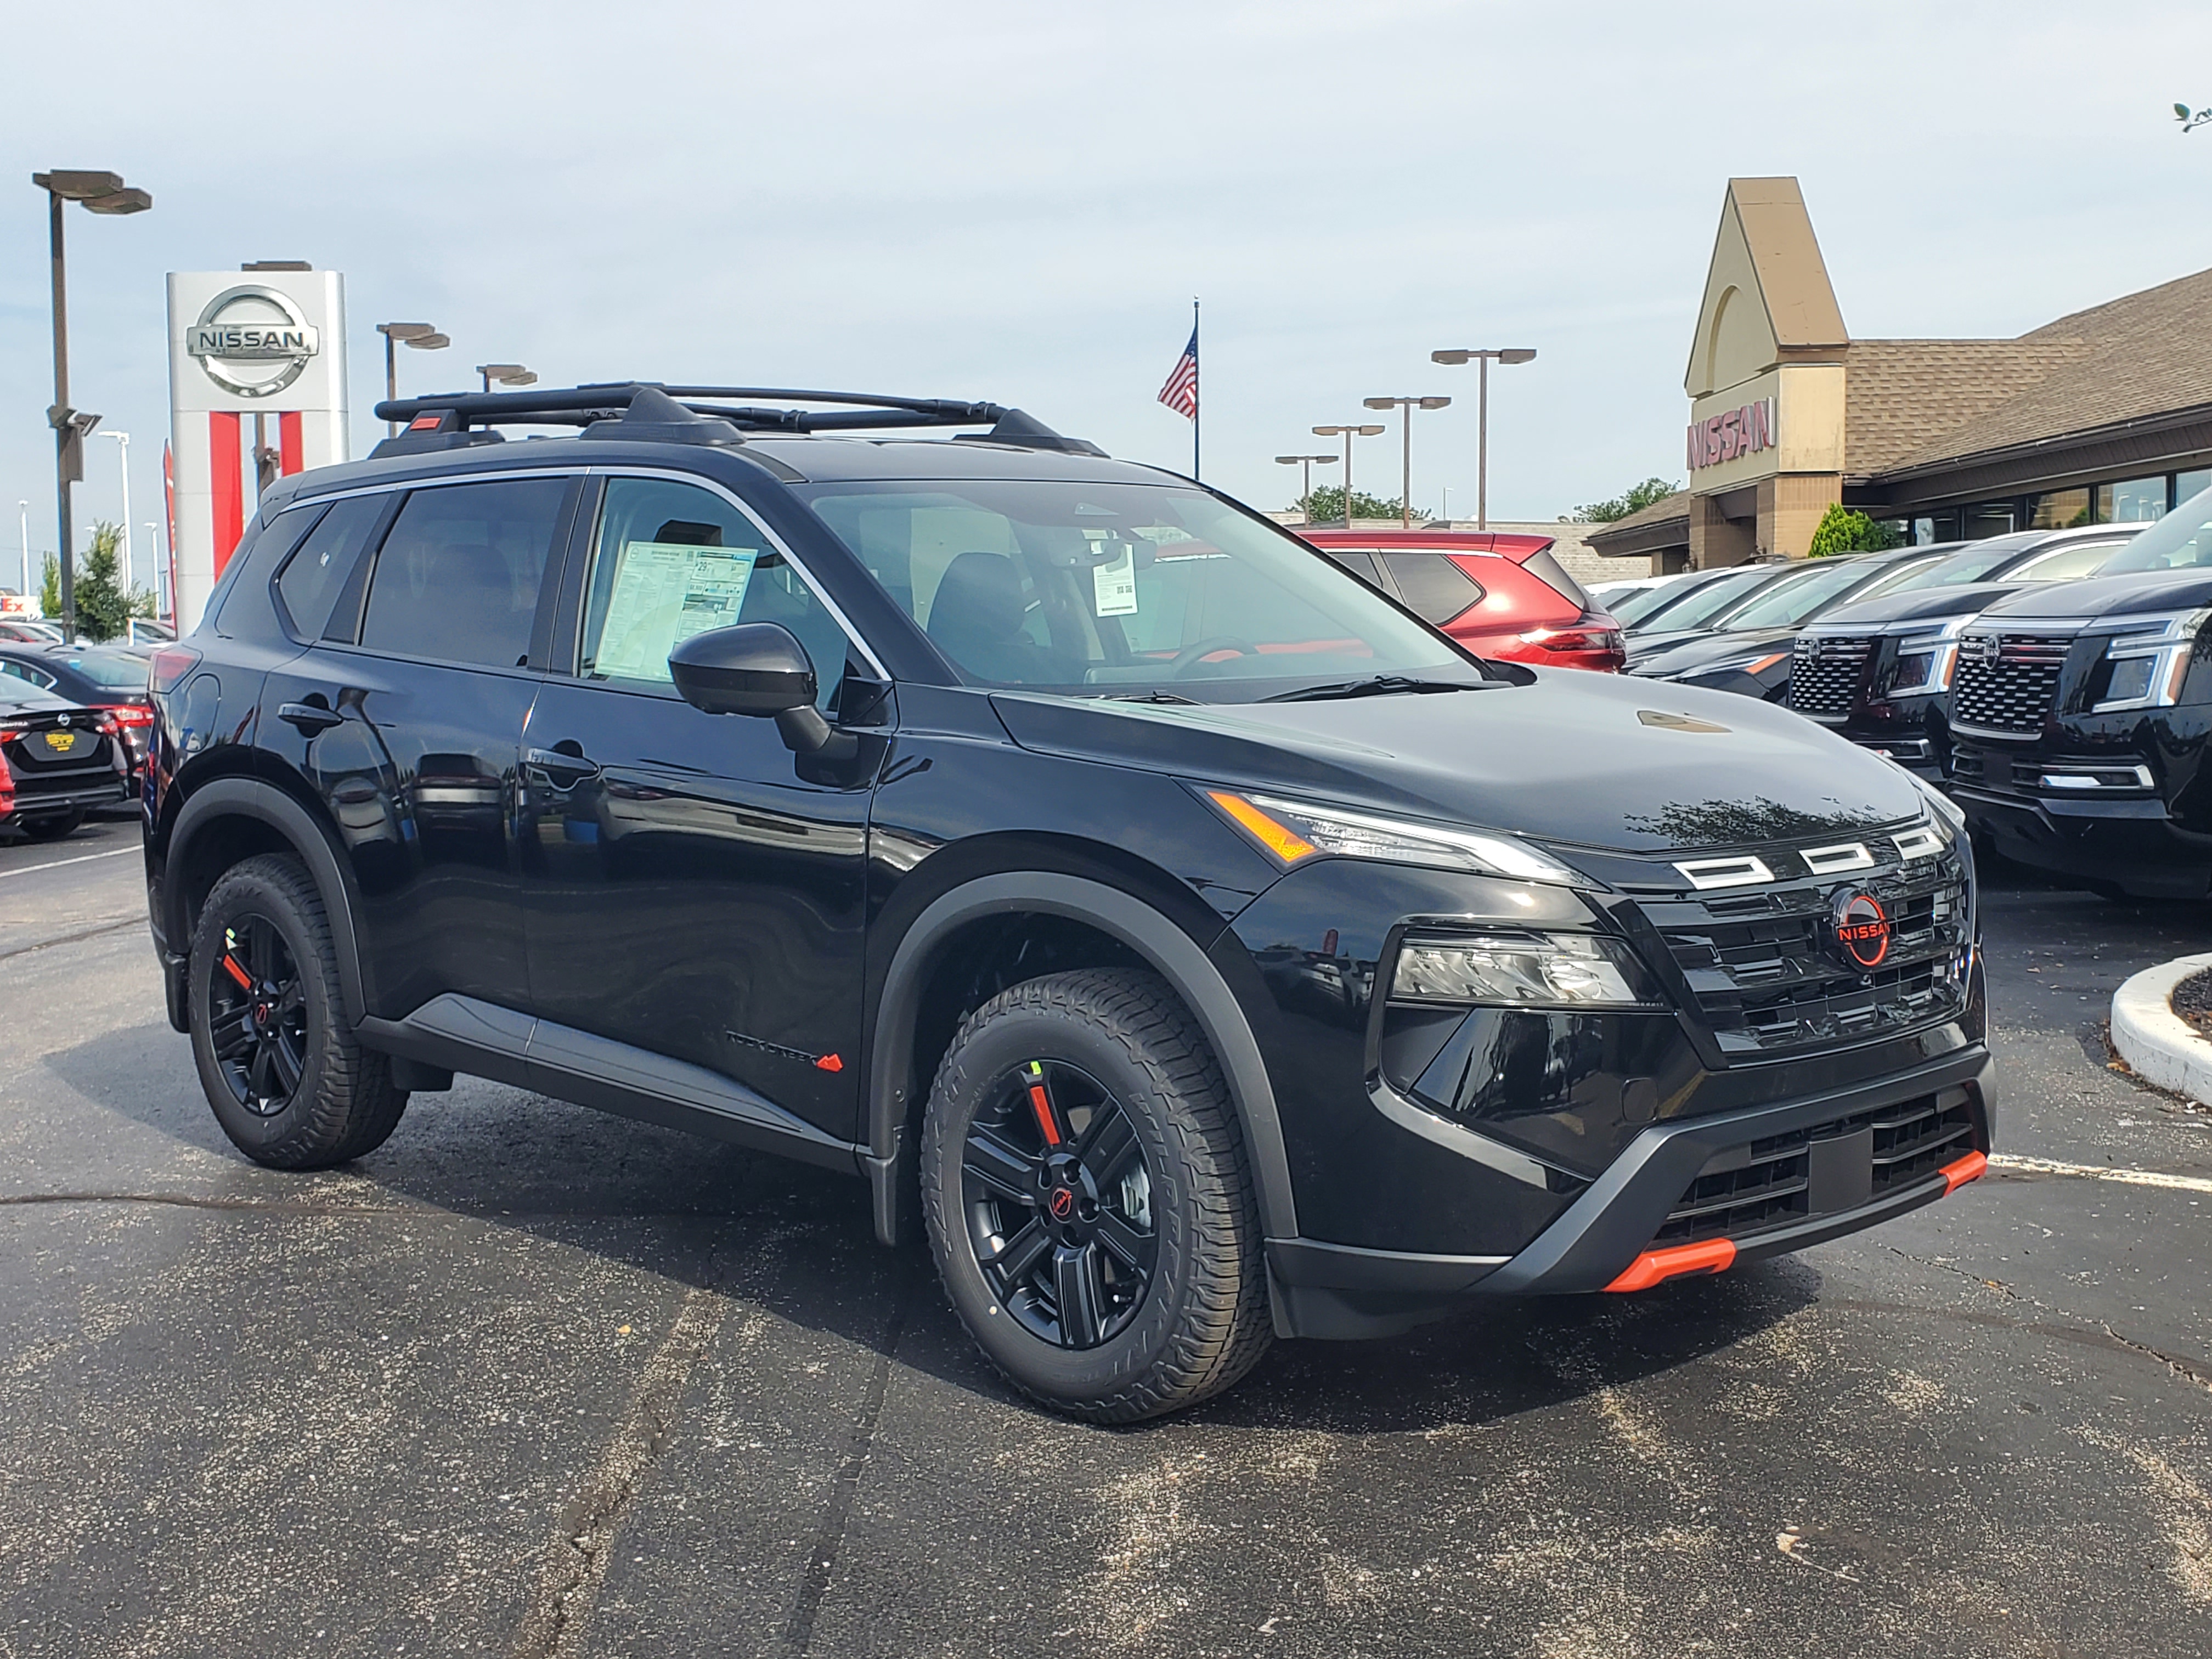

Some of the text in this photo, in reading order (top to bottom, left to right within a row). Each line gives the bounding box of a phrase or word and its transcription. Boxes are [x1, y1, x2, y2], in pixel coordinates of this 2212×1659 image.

[200, 331, 304, 348] NISSAN
[1687, 396, 1777, 471] NISSAN
[1838, 921, 1891, 941] NISSAN
